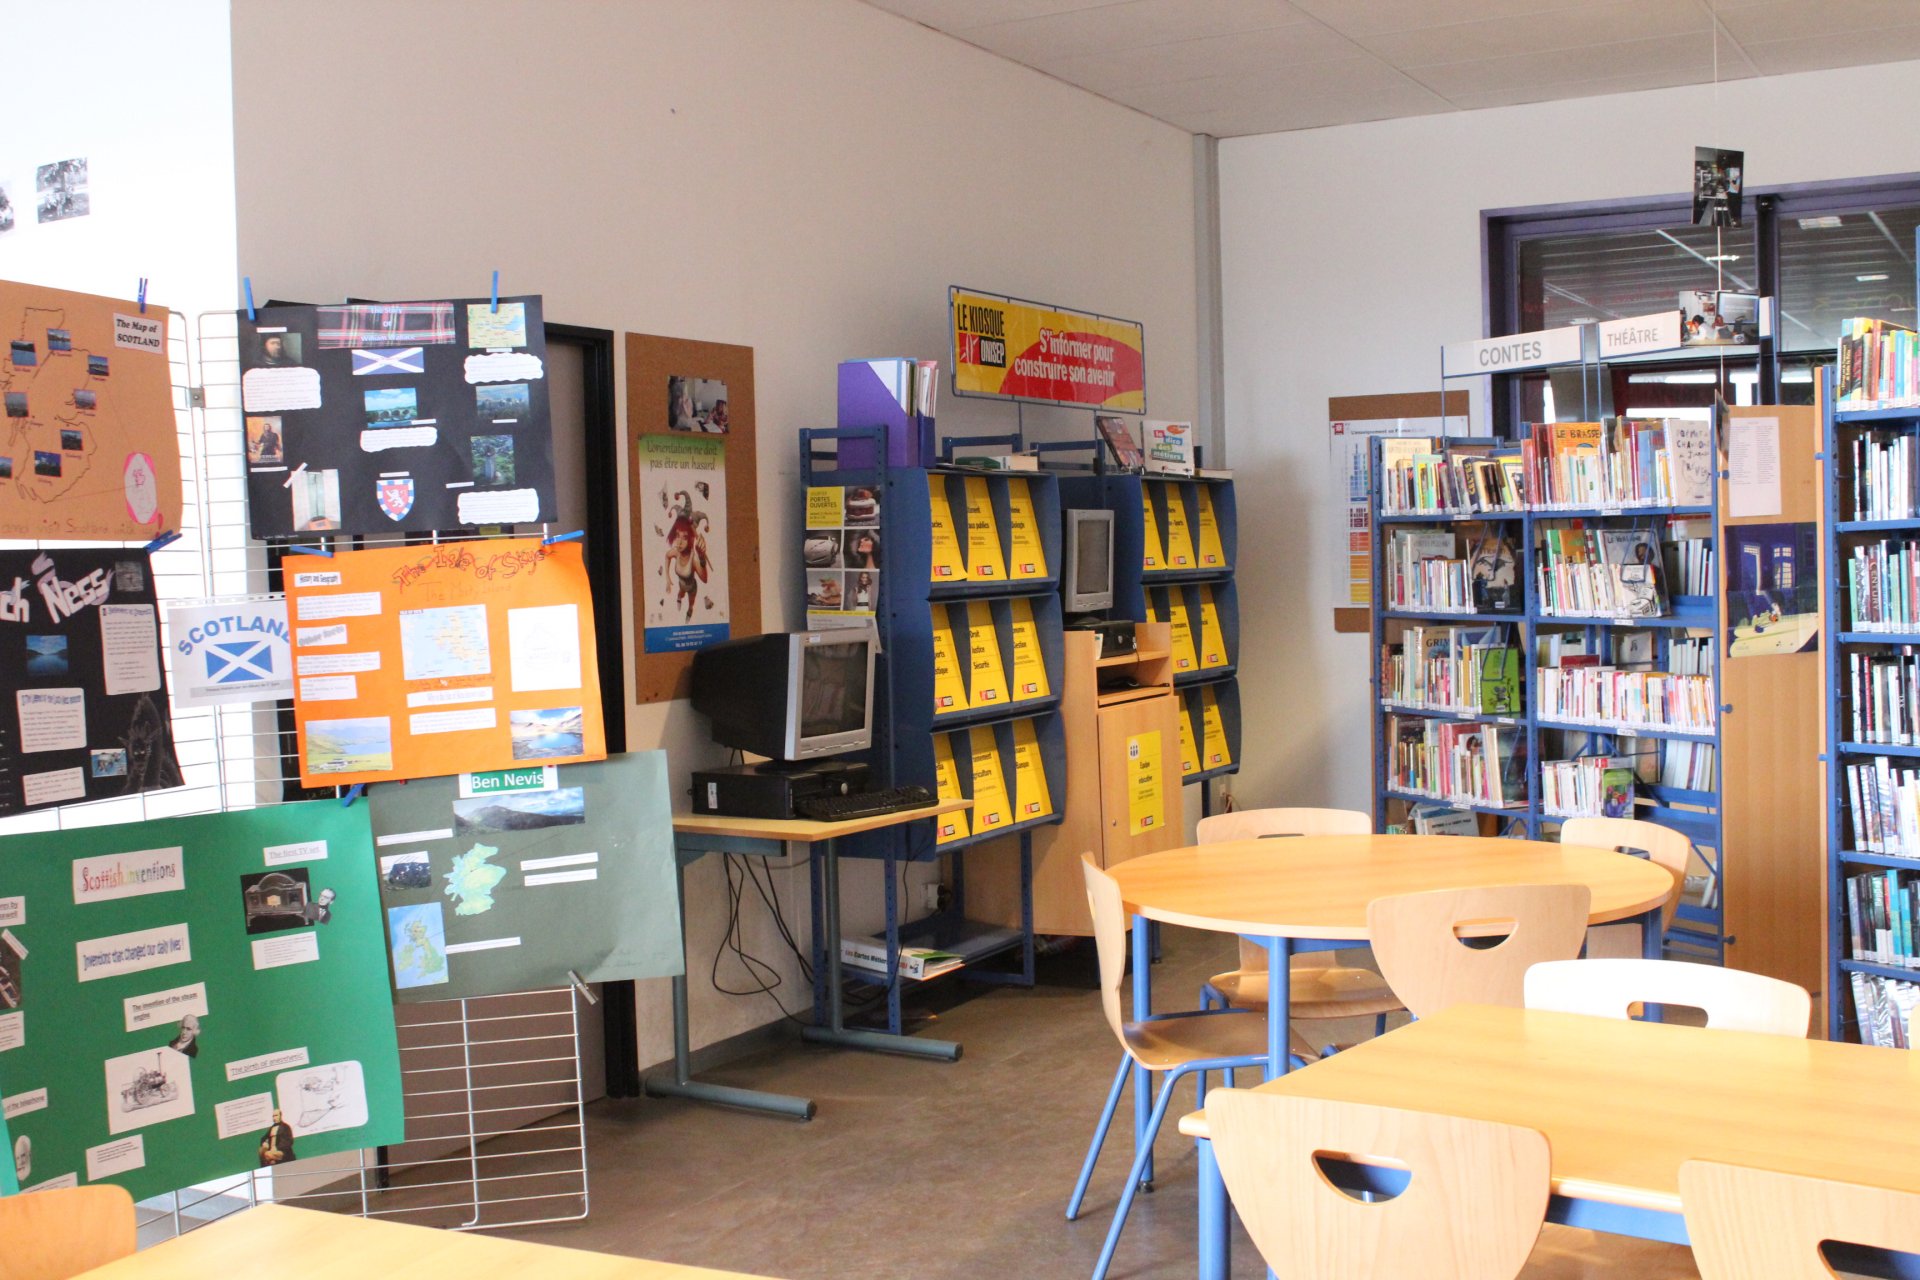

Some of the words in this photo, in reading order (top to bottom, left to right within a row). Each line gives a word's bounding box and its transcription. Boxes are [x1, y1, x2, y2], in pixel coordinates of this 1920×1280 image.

[116, 318, 131, 329] The
[132, 321, 147, 333] Map
[149, 325, 158, 333] of
[958, 303, 968, 331] LE
[969, 306, 1005, 337] KIOSQUE
[117, 333, 160, 348] SCOTLAND
[361, 334, 387, 342] William
[1038, 327, 1092, 360] S'informer
[1093, 344, 1114, 365] pour
[1607, 327, 1659, 347] THÉÂTRE
[980, 339, 1005, 365] ONISEP
[1479, 341, 1542, 366] CONTES
[1014, 356, 1068, 381] construire
[1069, 365, 1087, 384] son
[1087, 365, 1116, 388] avenir
[1556, 430, 1566, 438] LE
[694, 446, 703, 455] ne
[704, 443, 718, 456] doit
[650, 459, 663, 472] pas
[680, 460, 690, 469] un
[691, 456, 716, 471] hasard
[392, 564, 426, 588] The
[433, 545, 472, 571] Isle
[475, 554, 496, 581] of
[501, 548, 545, 576] Skye
[41, 567, 110, 624] Ness
[1869, 561, 1879, 610] CENTURY
[472, 774, 500, 790] Ben
[504, 770, 544, 787] Nevis
[82, 862, 125, 892] Scottish
[127, 860, 176, 885] inventions
[132, 1004, 142, 1012] The
